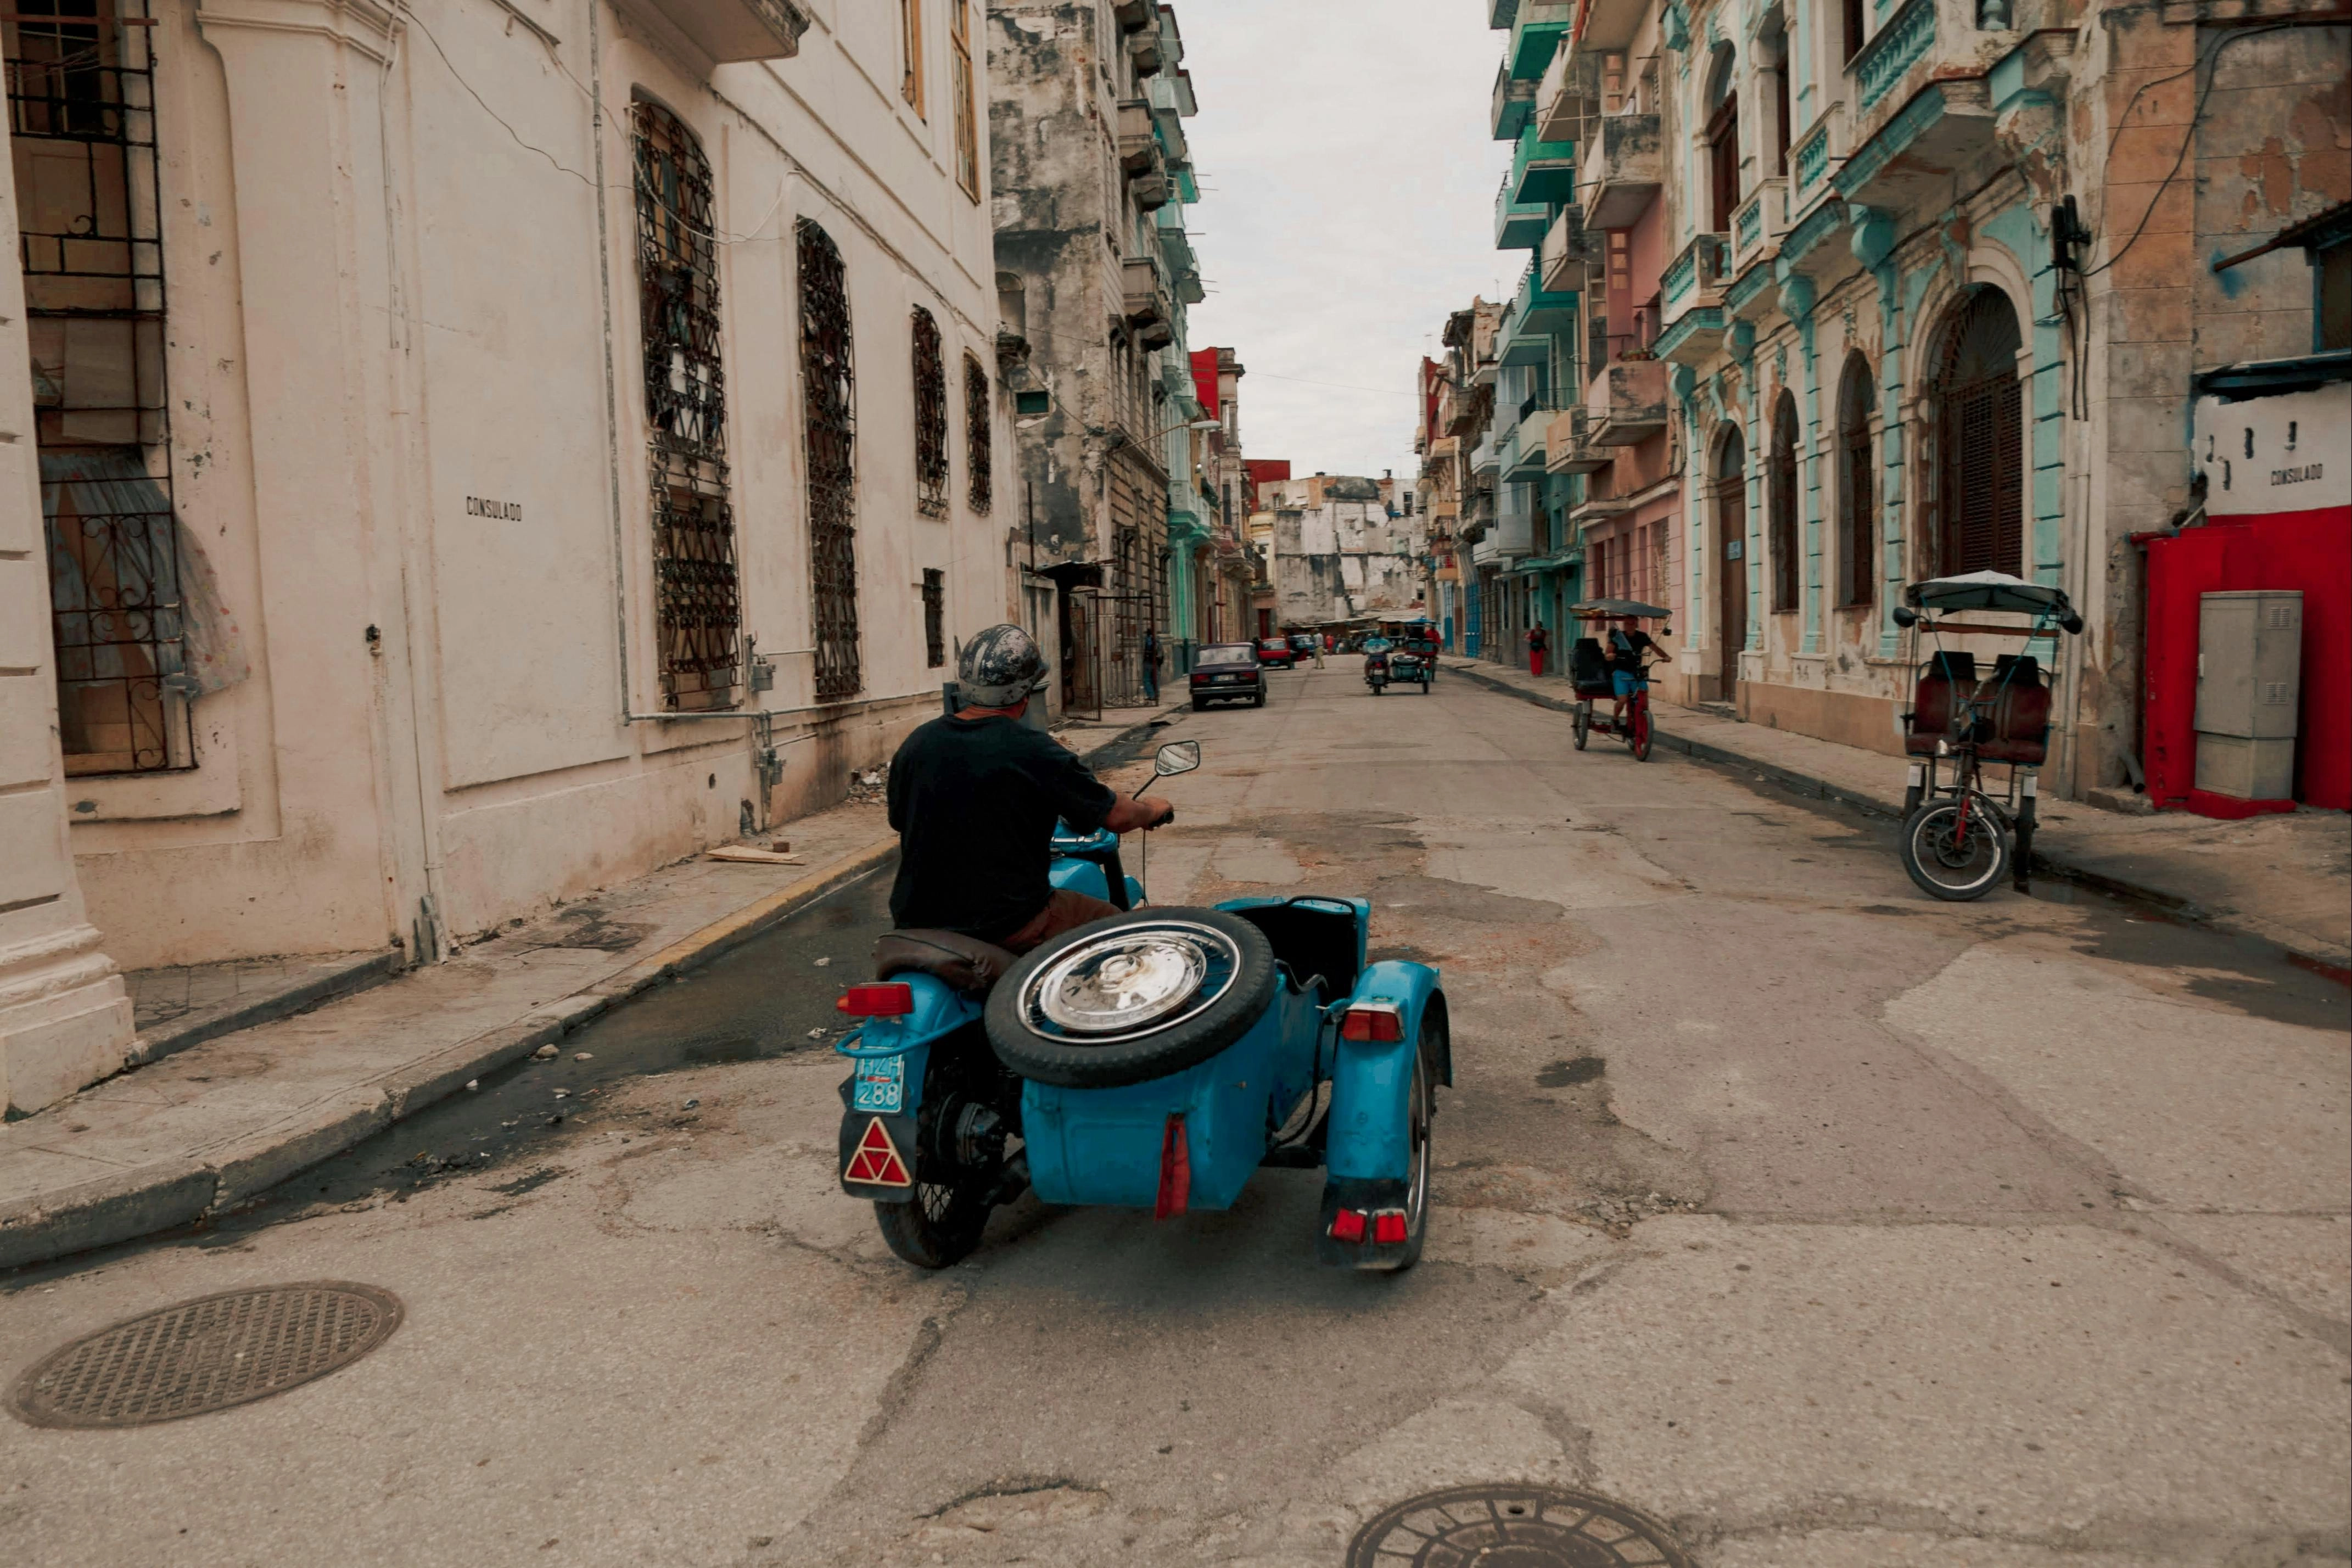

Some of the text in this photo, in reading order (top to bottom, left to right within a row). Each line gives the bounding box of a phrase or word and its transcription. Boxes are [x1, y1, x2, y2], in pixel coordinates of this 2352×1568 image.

[2271, 463, 2323, 486] CONSULADO
[467, 496, 522, 522] CONSULADO
[858, 1083, 899, 1106] 288
